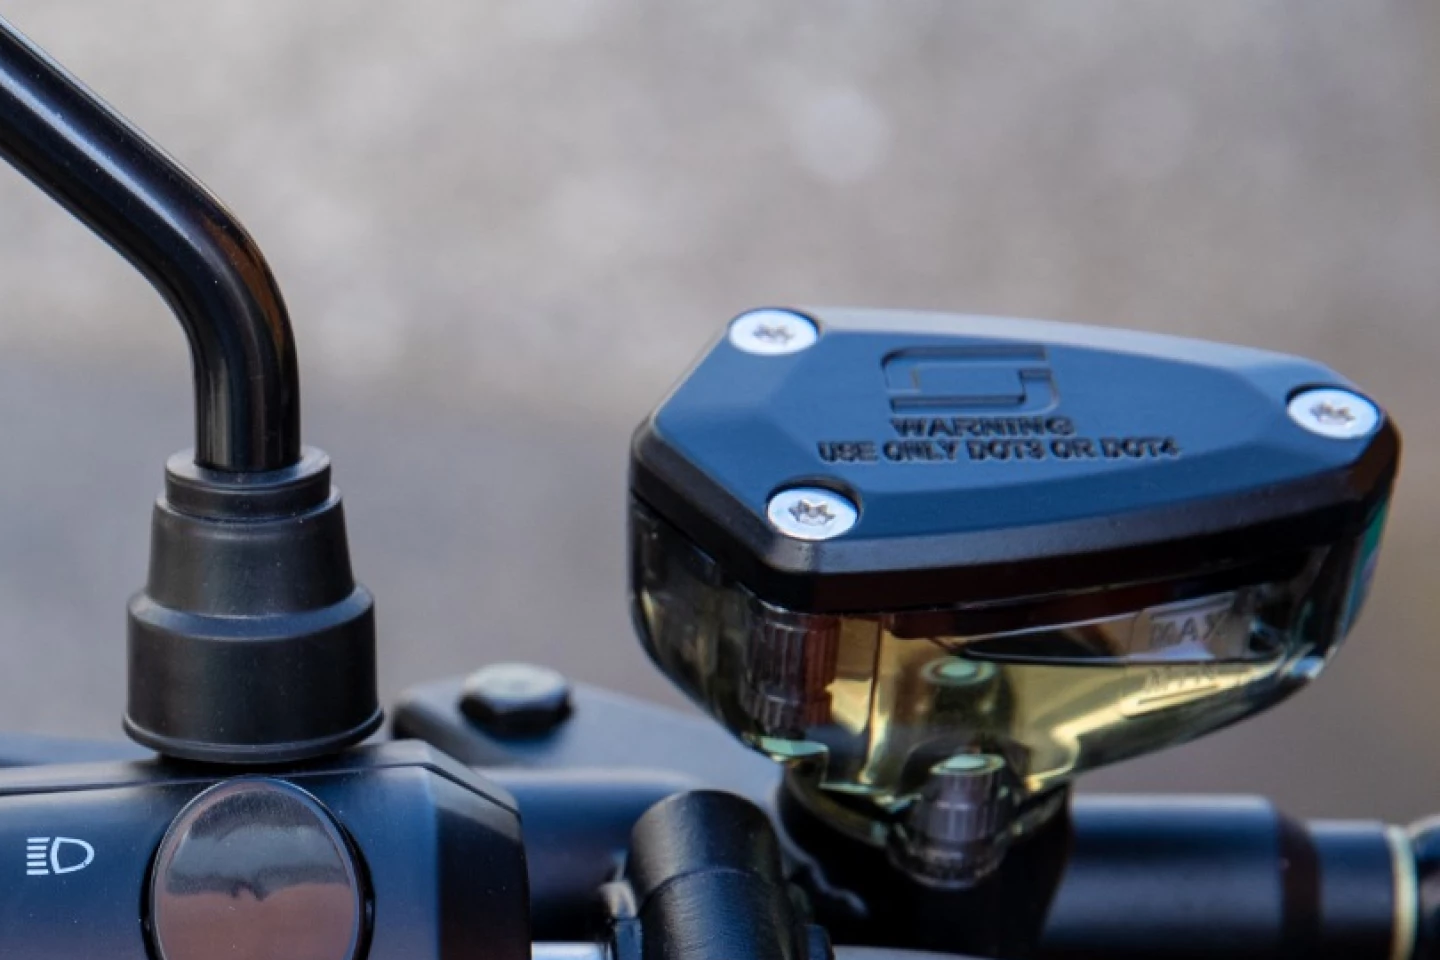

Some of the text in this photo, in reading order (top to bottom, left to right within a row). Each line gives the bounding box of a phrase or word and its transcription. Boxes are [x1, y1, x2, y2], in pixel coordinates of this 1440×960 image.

[891, 416, 1075, 438] WARNING
[817, 440, 879, 463] USE
[883, 438, 960, 462] ONLY
[1051, 437, 1097, 460] OR
[1101, 436, 1182, 459] DOT4
[1149, 611, 1227, 646] MAX
